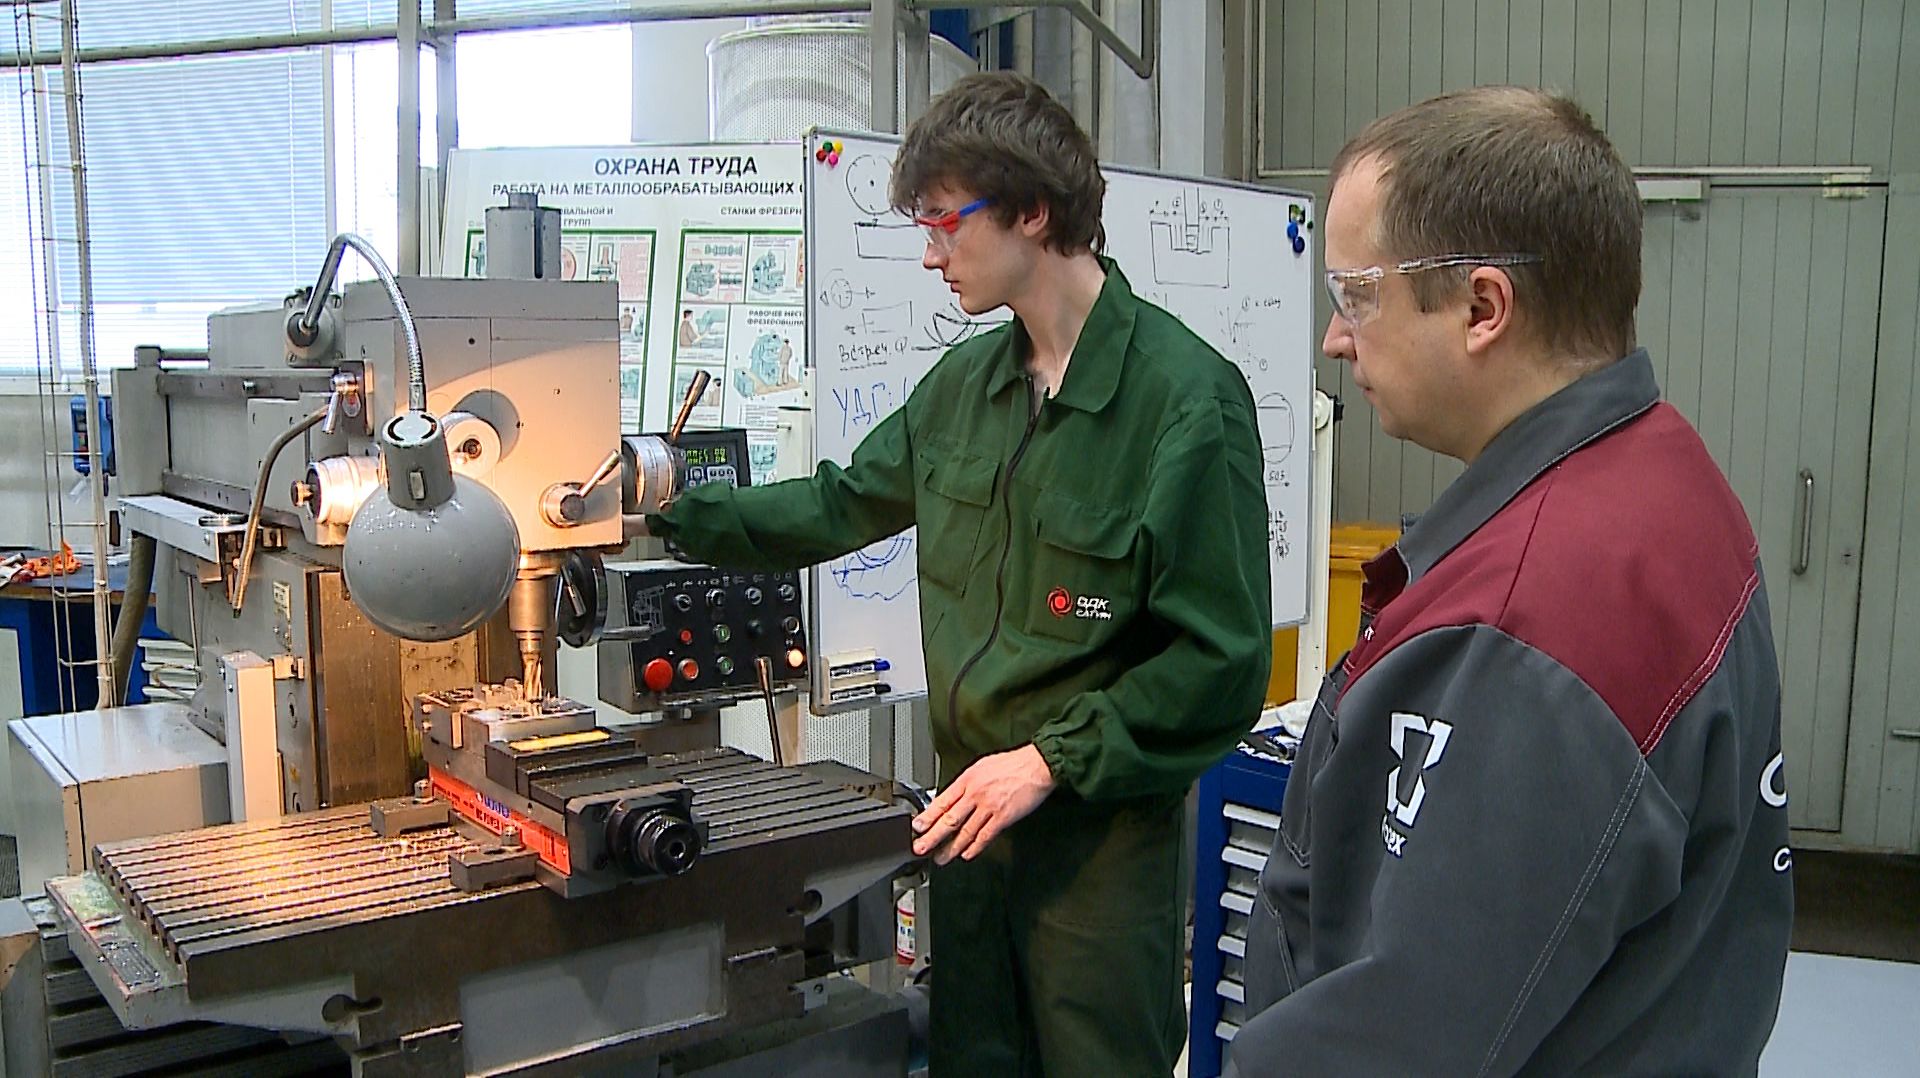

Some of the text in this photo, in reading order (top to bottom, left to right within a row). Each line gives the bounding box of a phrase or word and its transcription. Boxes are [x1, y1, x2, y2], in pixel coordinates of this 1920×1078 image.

[594, 156, 758, 178] ОХРАНА ТРУДА
[492, 184, 546, 195] РАБОТА
[551, 183, 570, 195] НА
[573, 182, 795, 196] МЕТАЛЛООБРАБАТЫВАЮЩИХ
[561, 206, 605, 215] ВАЛЬНОЙ
[720, 206, 802, 215] СТАНКИ ФРЕЗЕРН
[563, 217, 591, 227] ГРУПП
